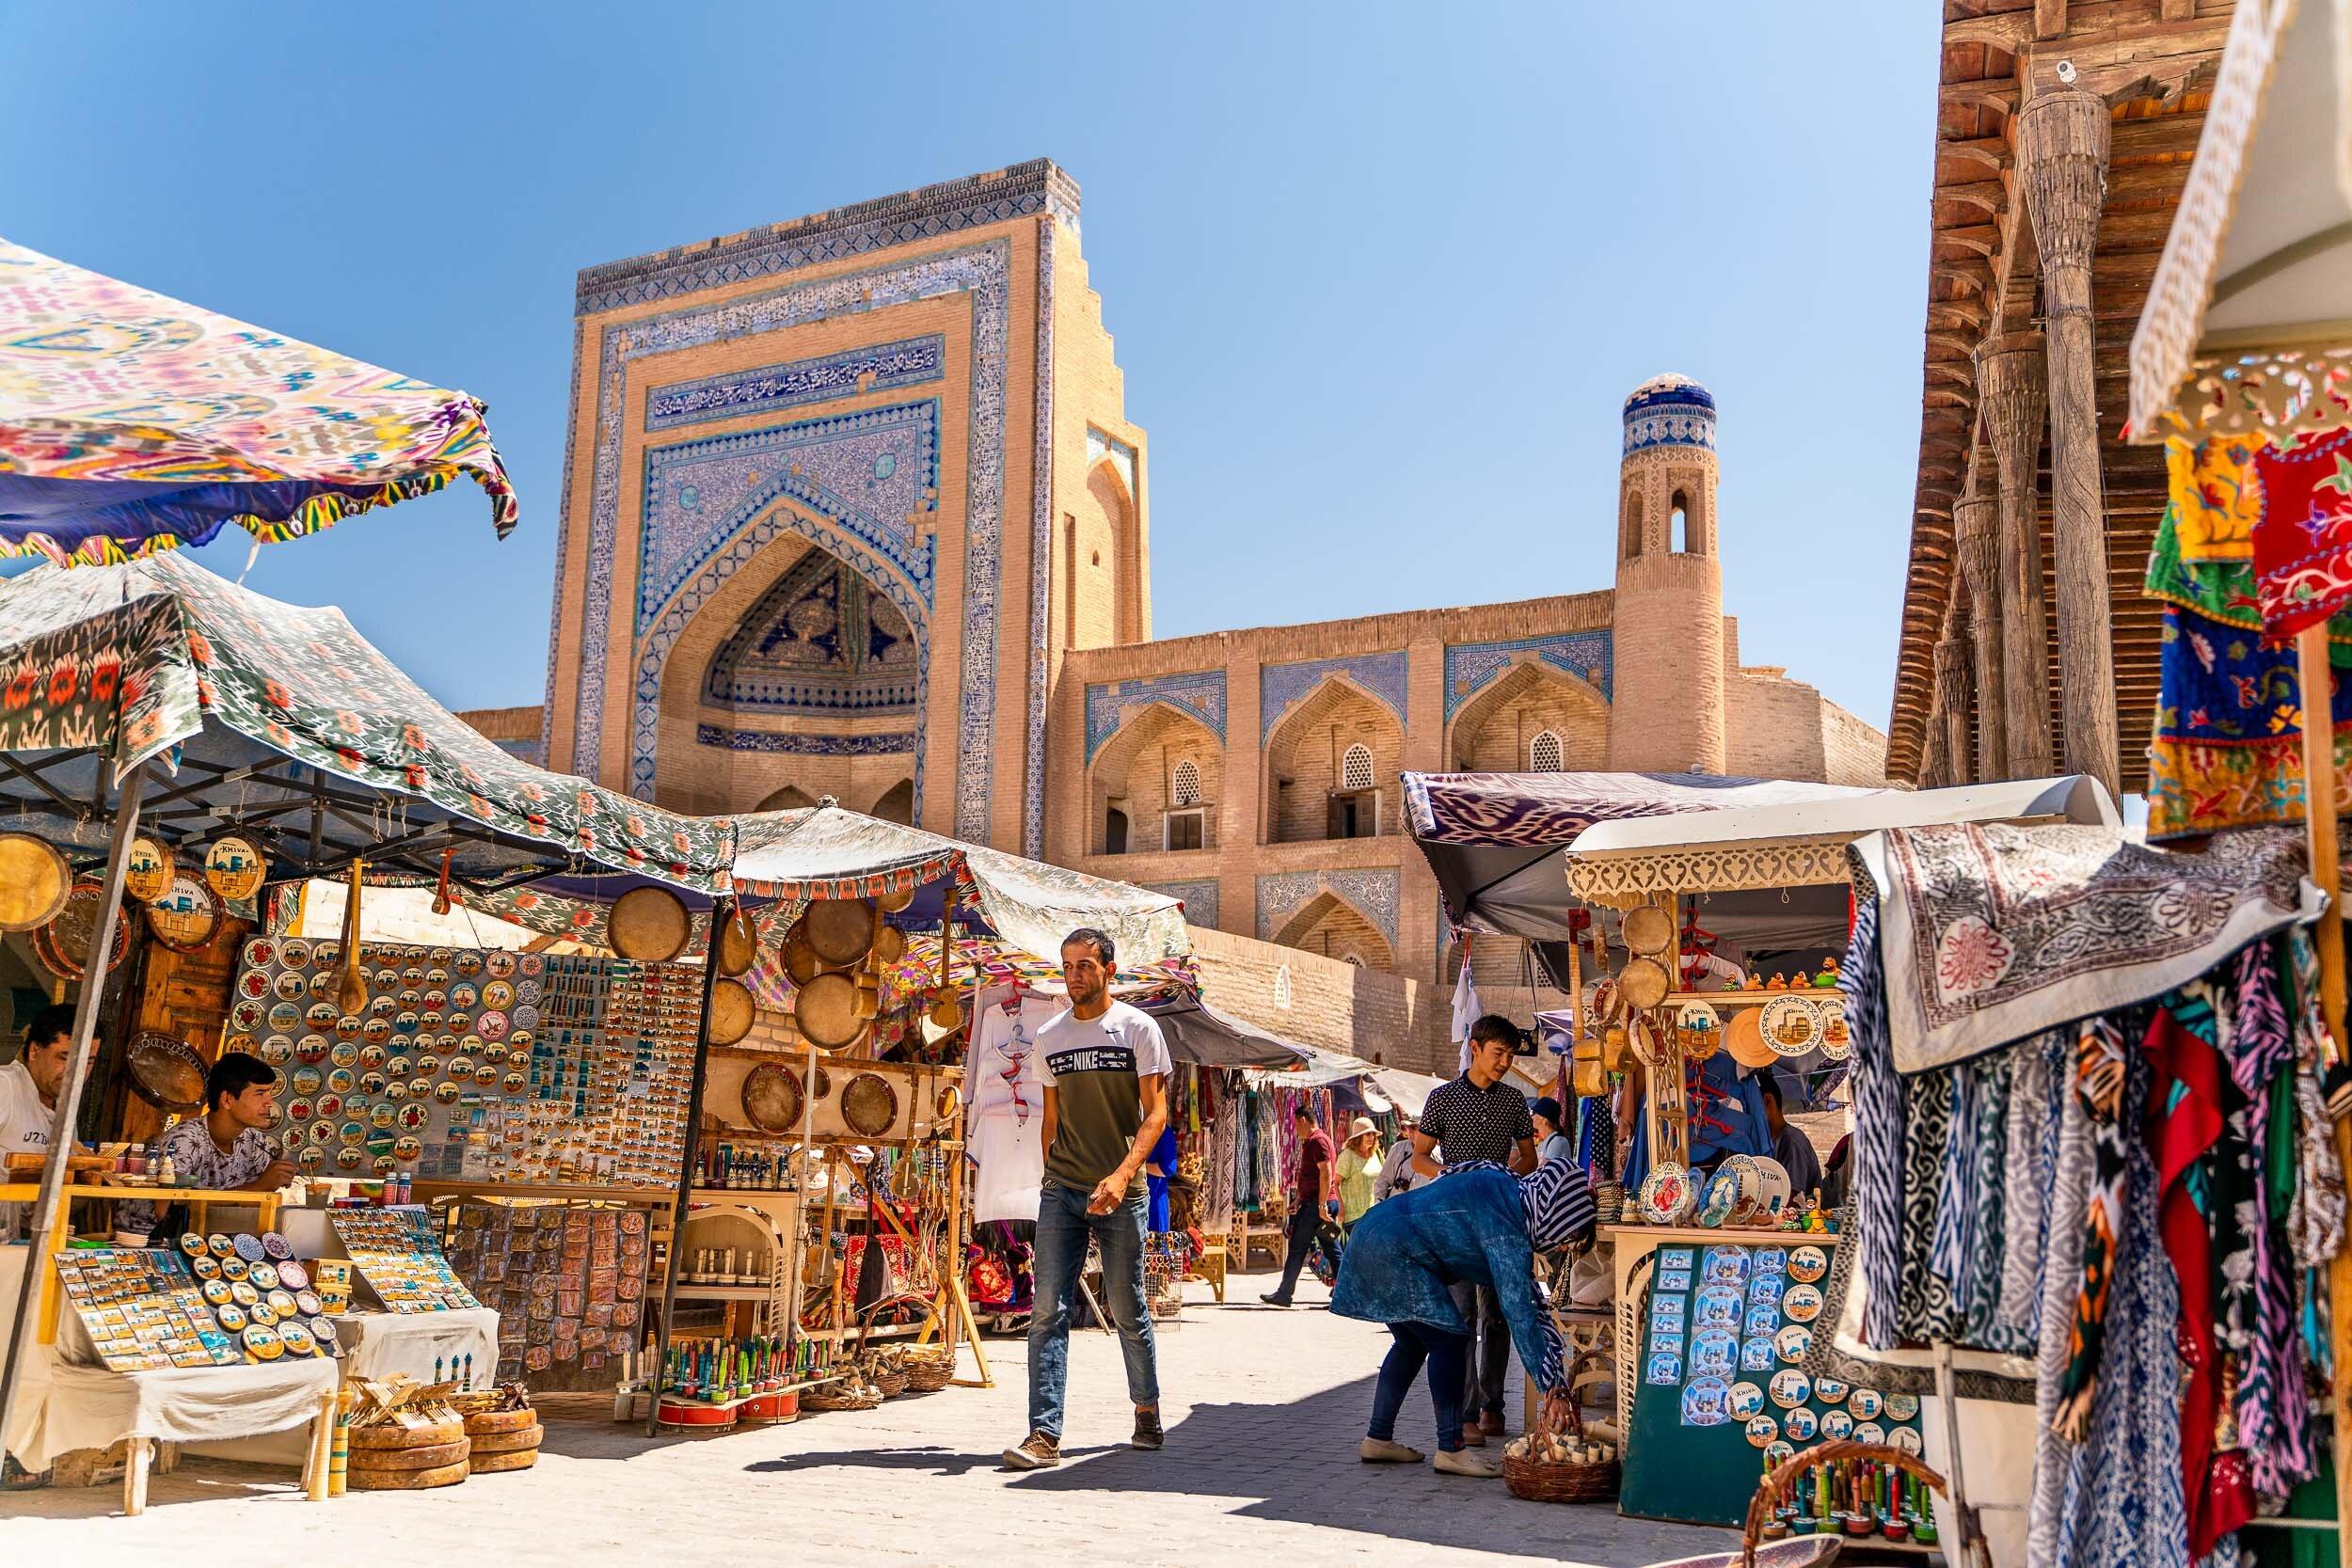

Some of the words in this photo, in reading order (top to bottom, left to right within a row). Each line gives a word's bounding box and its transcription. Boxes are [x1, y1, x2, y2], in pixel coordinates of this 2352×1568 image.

[171, 886, 194, 895] HIVA
[1073, 1051, 1099, 1070] NIKE
[1761, 1171, 1780, 1180] HIVA
[1736, 1388, 1756, 1397] KHIVA
